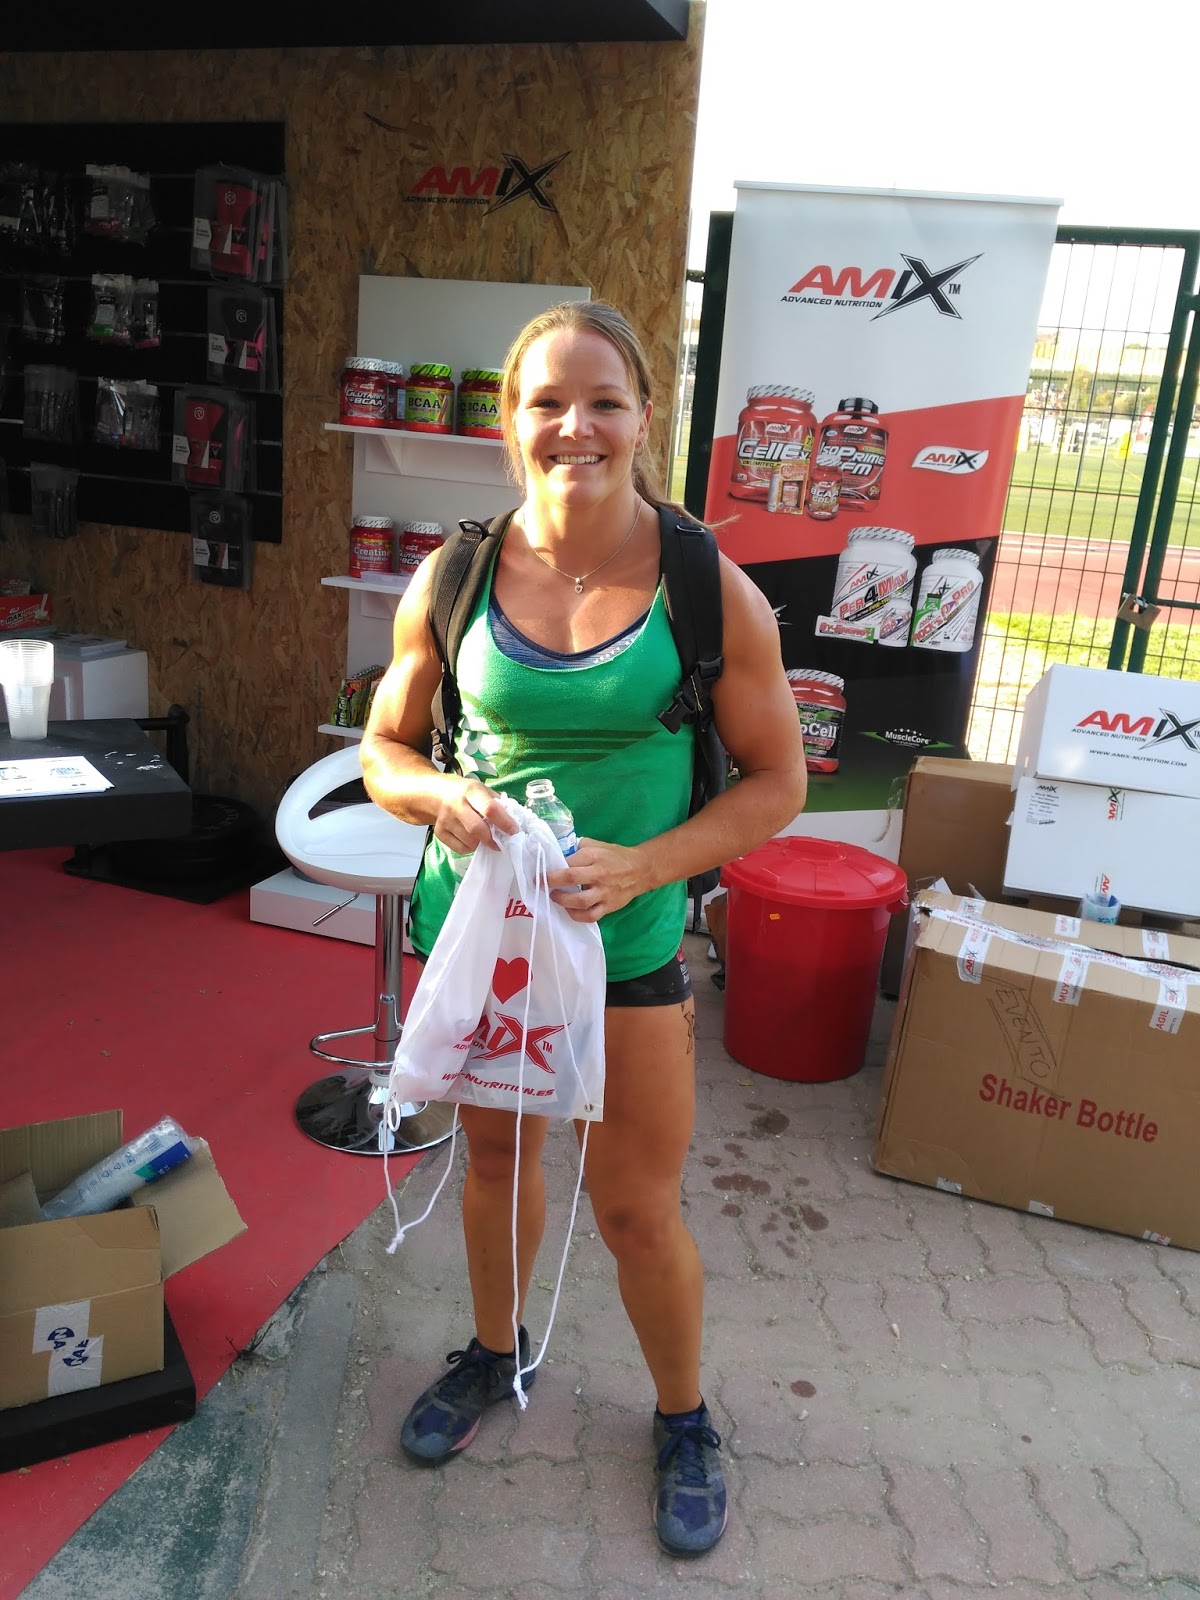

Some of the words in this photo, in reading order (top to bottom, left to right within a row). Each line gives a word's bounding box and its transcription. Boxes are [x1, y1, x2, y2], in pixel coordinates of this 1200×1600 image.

[409, 151, 572, 216] AMIX
[404, 196, 448, 204] ADVANCED
[449, 197, 490, 205] NUTRITION
[788, 252, 985, 322] AMIX
[781, 295, 832, 305] ADVANCED
[834, 299, 882, 308] NUTRITION
[409, 397, 441, 408] BCAA
[922, 450, 984, 470] AMIX
[811, 488, 839, 497] BCAA
[812, 496, 837, 504] GOLD
[354, 546, 391, 557] Creatine
[885, 731, 930, 745] MuscleCore
[1071, 728, 1109, 738] ADVANCED
[1111, 733, 1147, 743] NUTRITION
[1076, 707, 1200, 753] AMIX
[1089, 749, 1188, 768] WWW.AMIX-NUTRITION.COM
[1058, 980, 1070, 1004] MUY
[995, 988, 1051, 1080] EVENTO
[979, 1073, 1072, 1121] Shaker
[1076, 1098, 1158, 1143] Bottle
